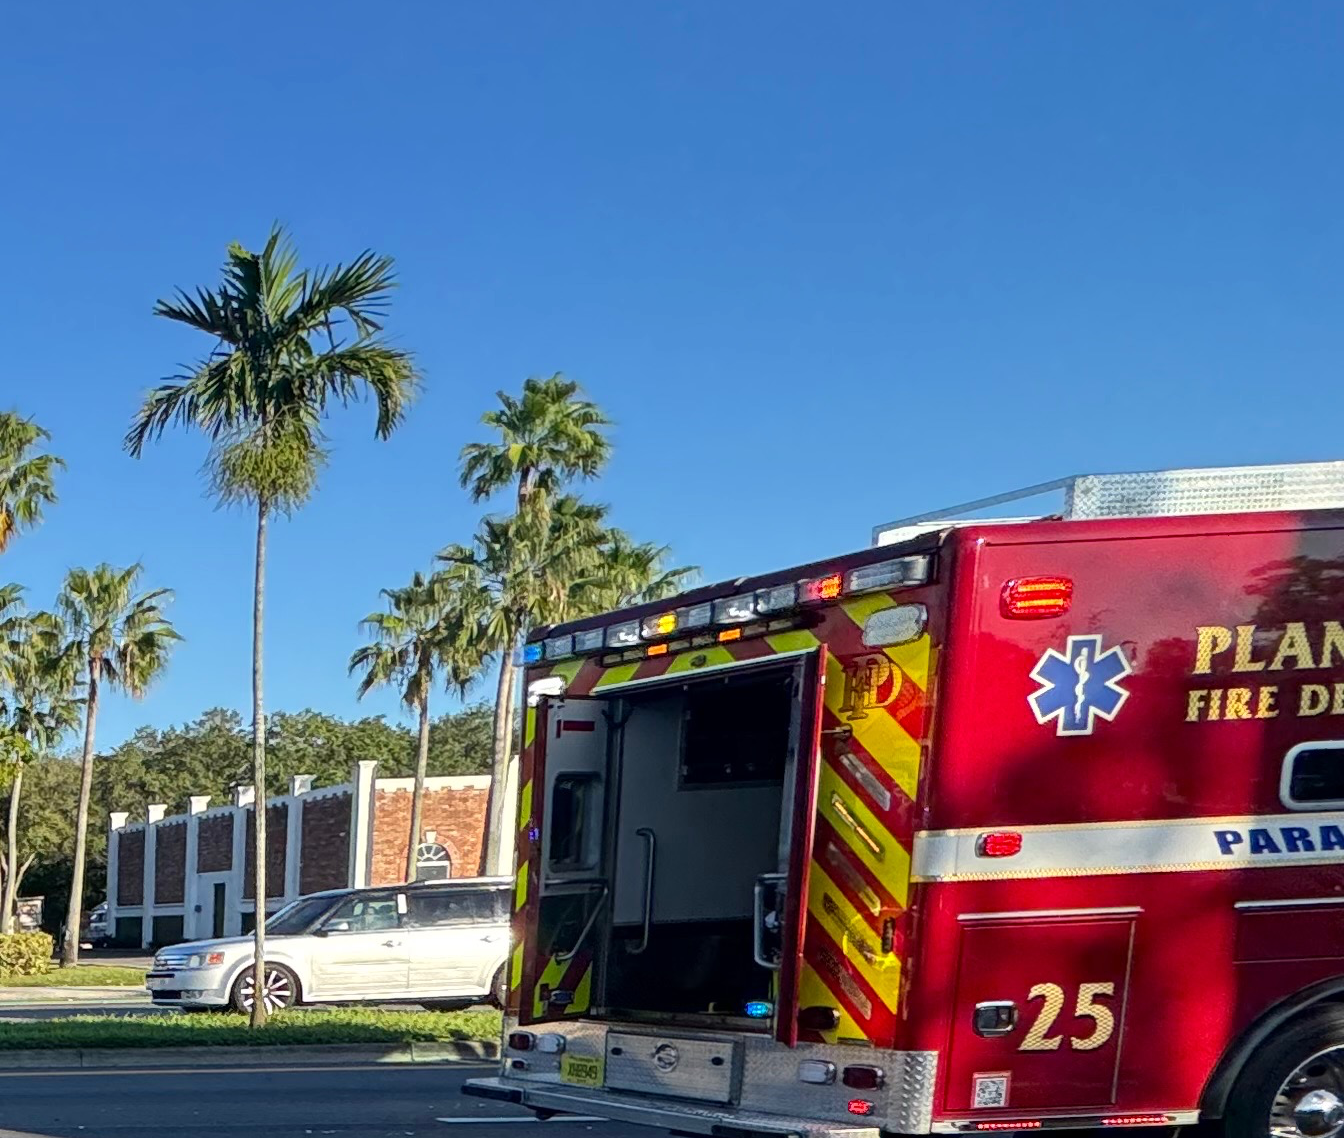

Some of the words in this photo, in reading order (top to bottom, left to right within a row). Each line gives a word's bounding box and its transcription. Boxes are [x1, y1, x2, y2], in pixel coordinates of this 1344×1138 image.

[1185, 686, 1280, 722] FIRE
[1213, 825, 1344, 855] PARA
[1018, 982, 1115, 1051] 25
